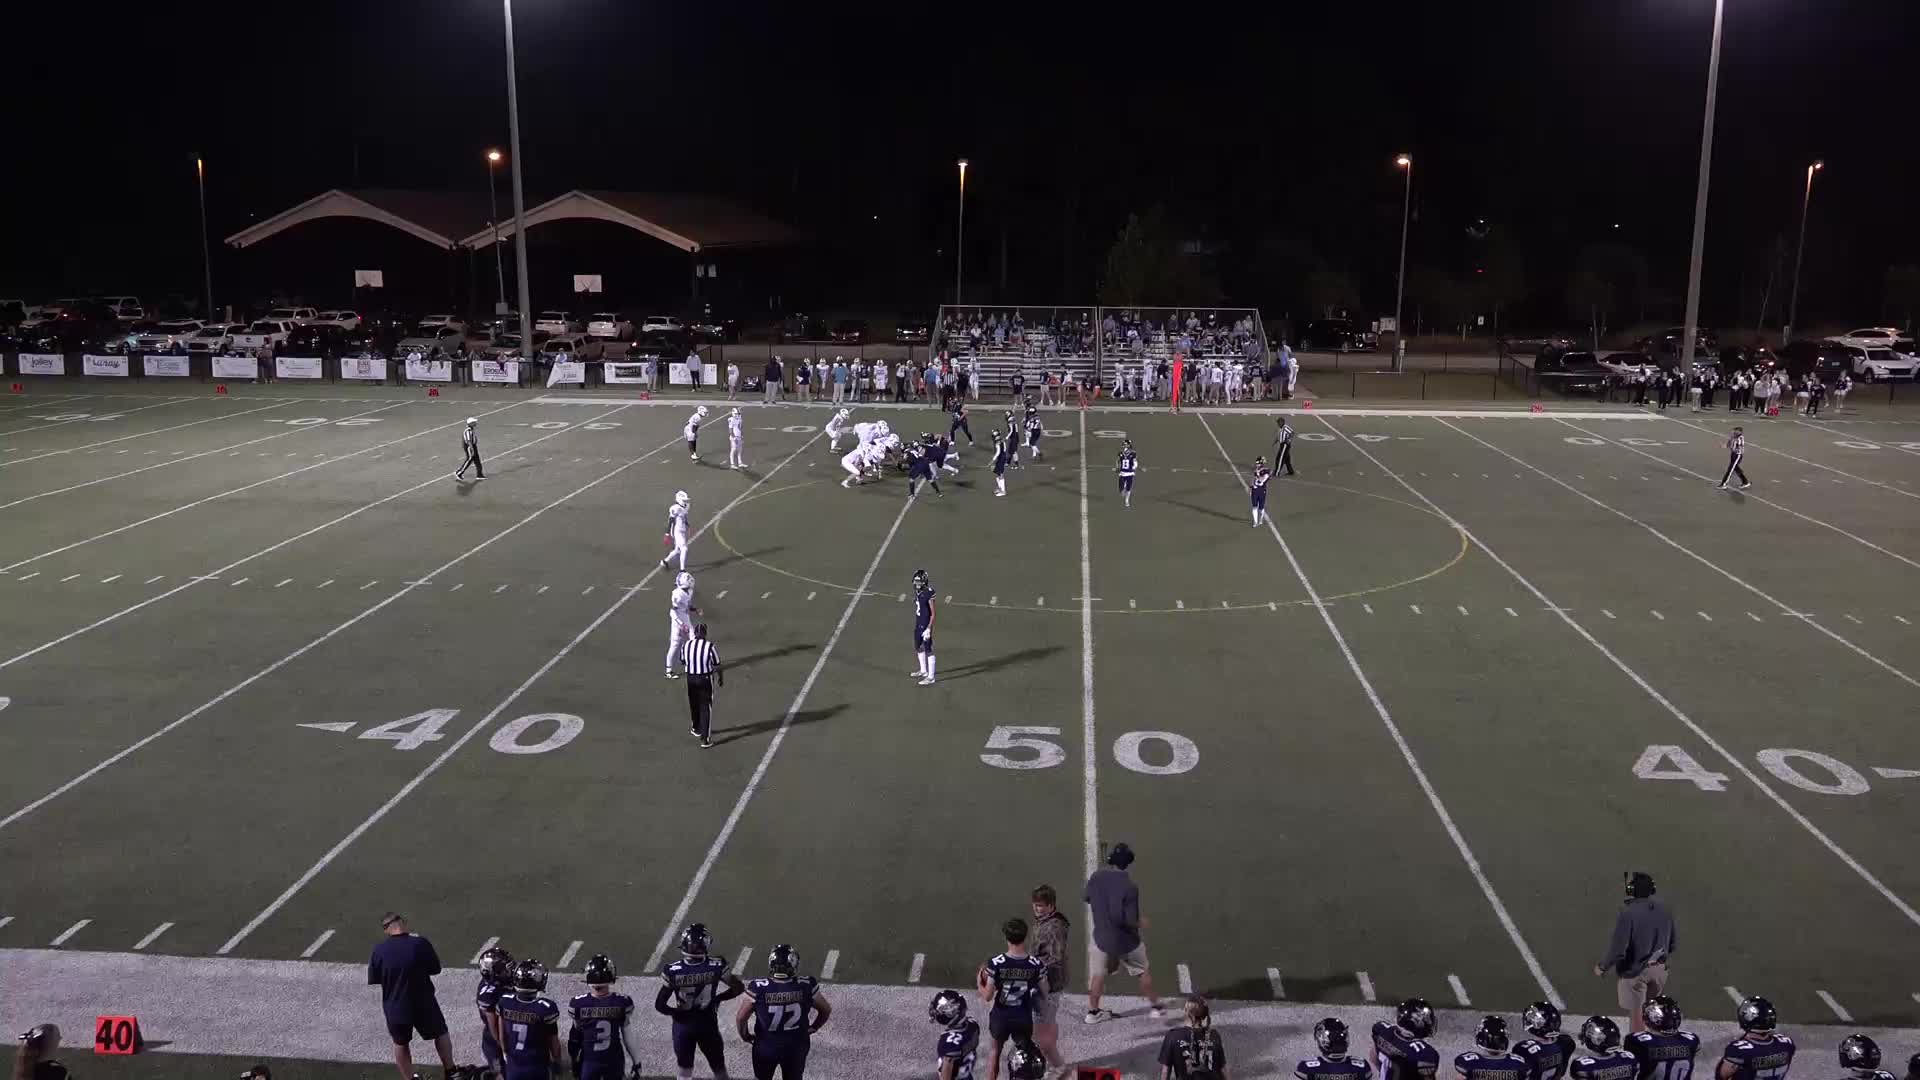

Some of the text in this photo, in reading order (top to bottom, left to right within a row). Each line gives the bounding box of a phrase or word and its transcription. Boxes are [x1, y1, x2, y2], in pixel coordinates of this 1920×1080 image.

[768, 1003, 802, 1031] 72
[96, 1019, 133, 1051] 40
[512, 1024, 528, 1050] 7
[593, 1020, 612, 1051] 3
